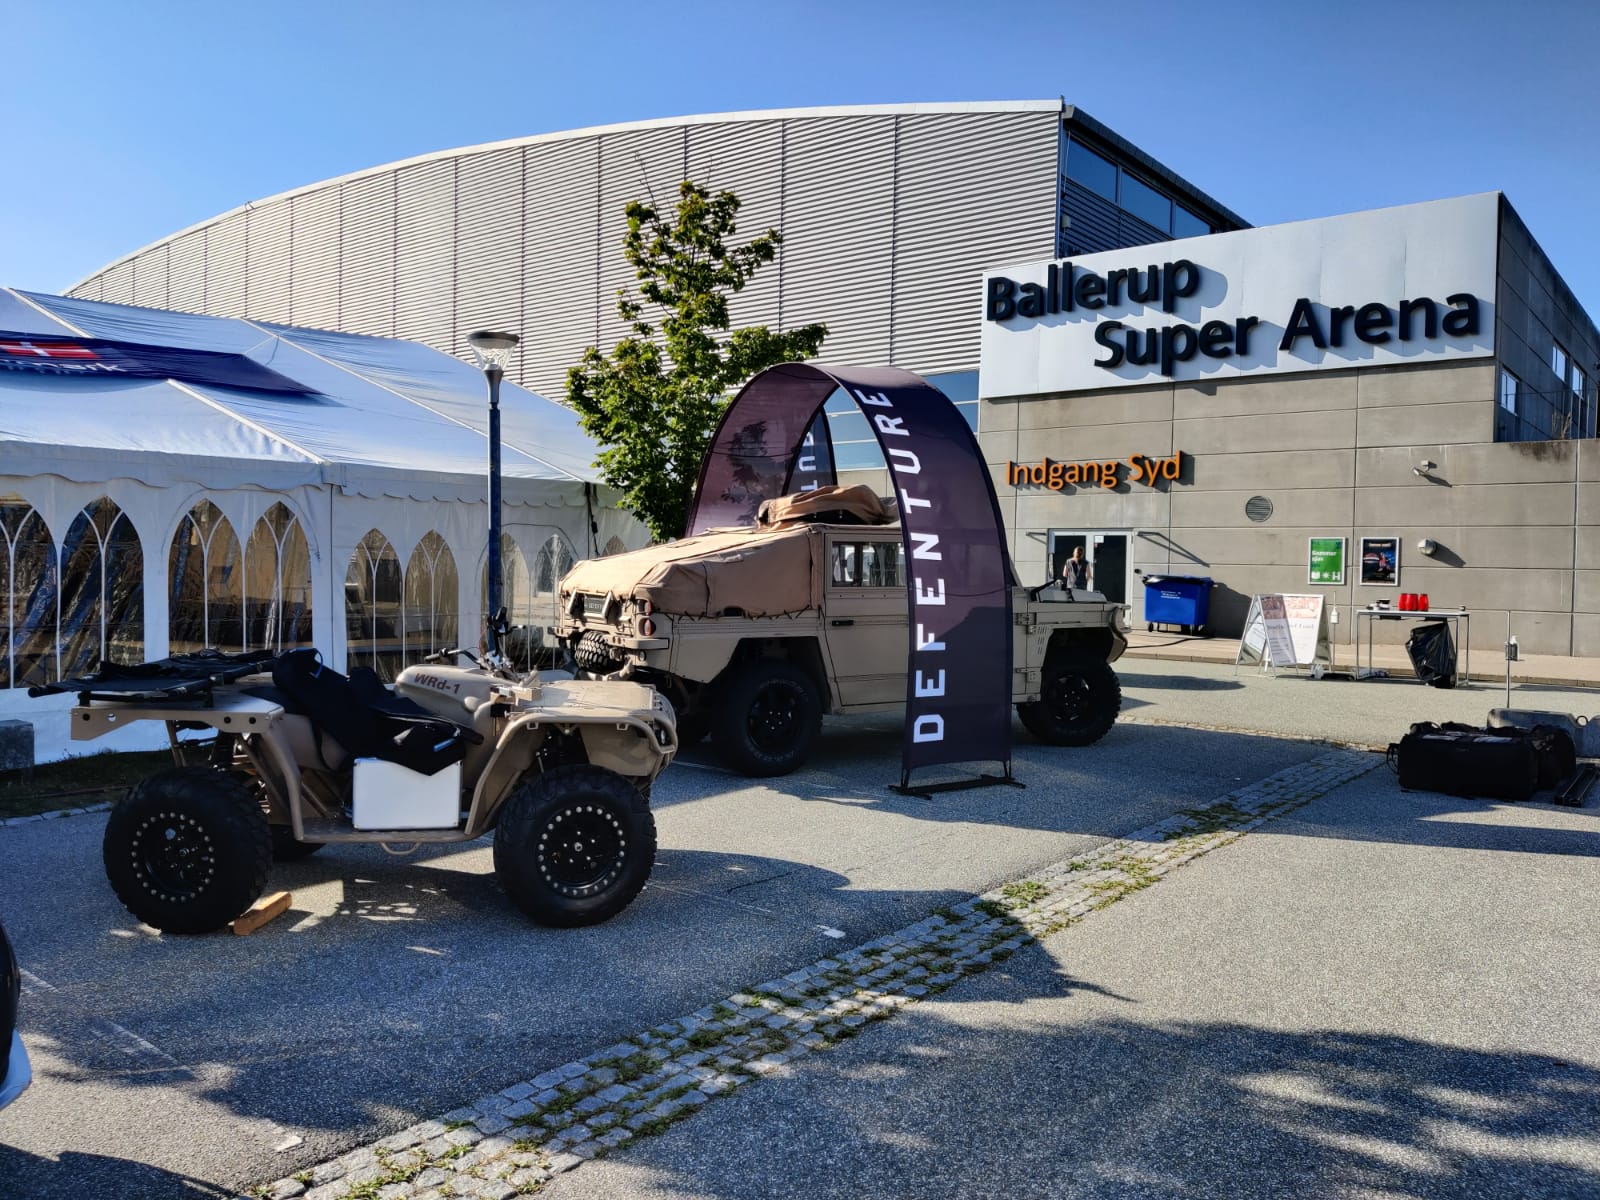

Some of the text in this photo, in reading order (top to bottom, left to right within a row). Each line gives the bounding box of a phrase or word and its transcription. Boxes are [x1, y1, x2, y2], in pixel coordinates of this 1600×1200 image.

[985, 258, 1200, 322] Ballerup
[1094, 291, 1480, 376] Super Arena
[1005, 450, 1183, 491] Indgang Syd
[855, 388, 946, 744] DEFENTURE
[414, 672, 461, 695] WRd-1
